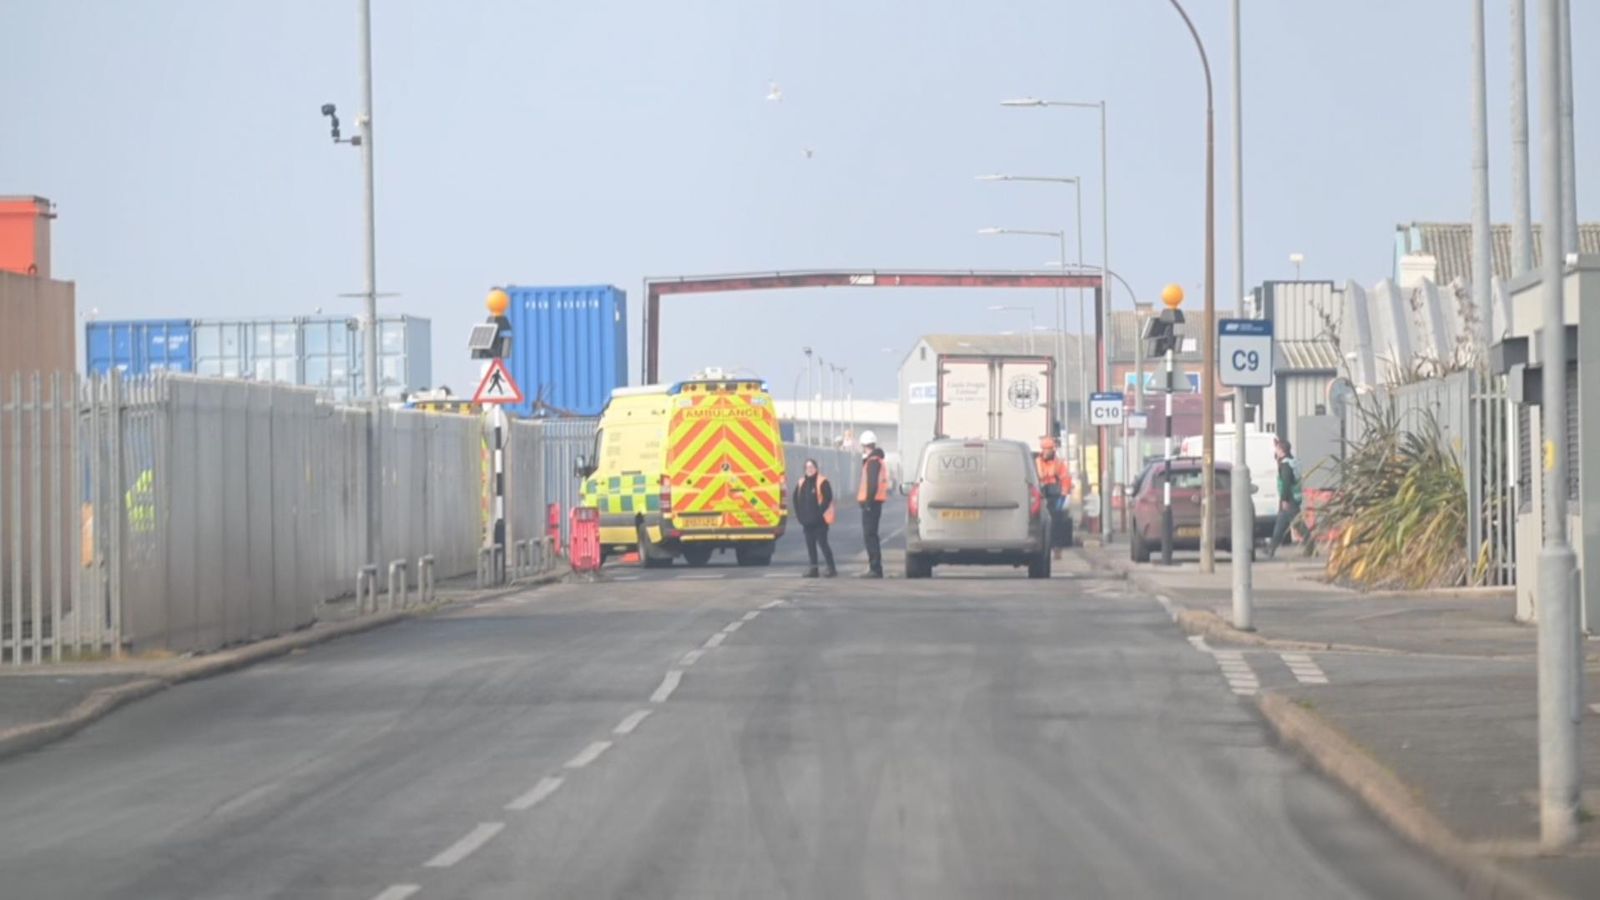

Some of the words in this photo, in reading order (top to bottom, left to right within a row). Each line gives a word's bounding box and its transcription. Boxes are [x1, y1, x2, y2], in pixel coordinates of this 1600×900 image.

[1231, 349, 1260, 371] C9
[685, 408, 761, 419] AMBULANCE
[1094, 406, 1120, 419] C10
[942, 456, 979, 470] van
